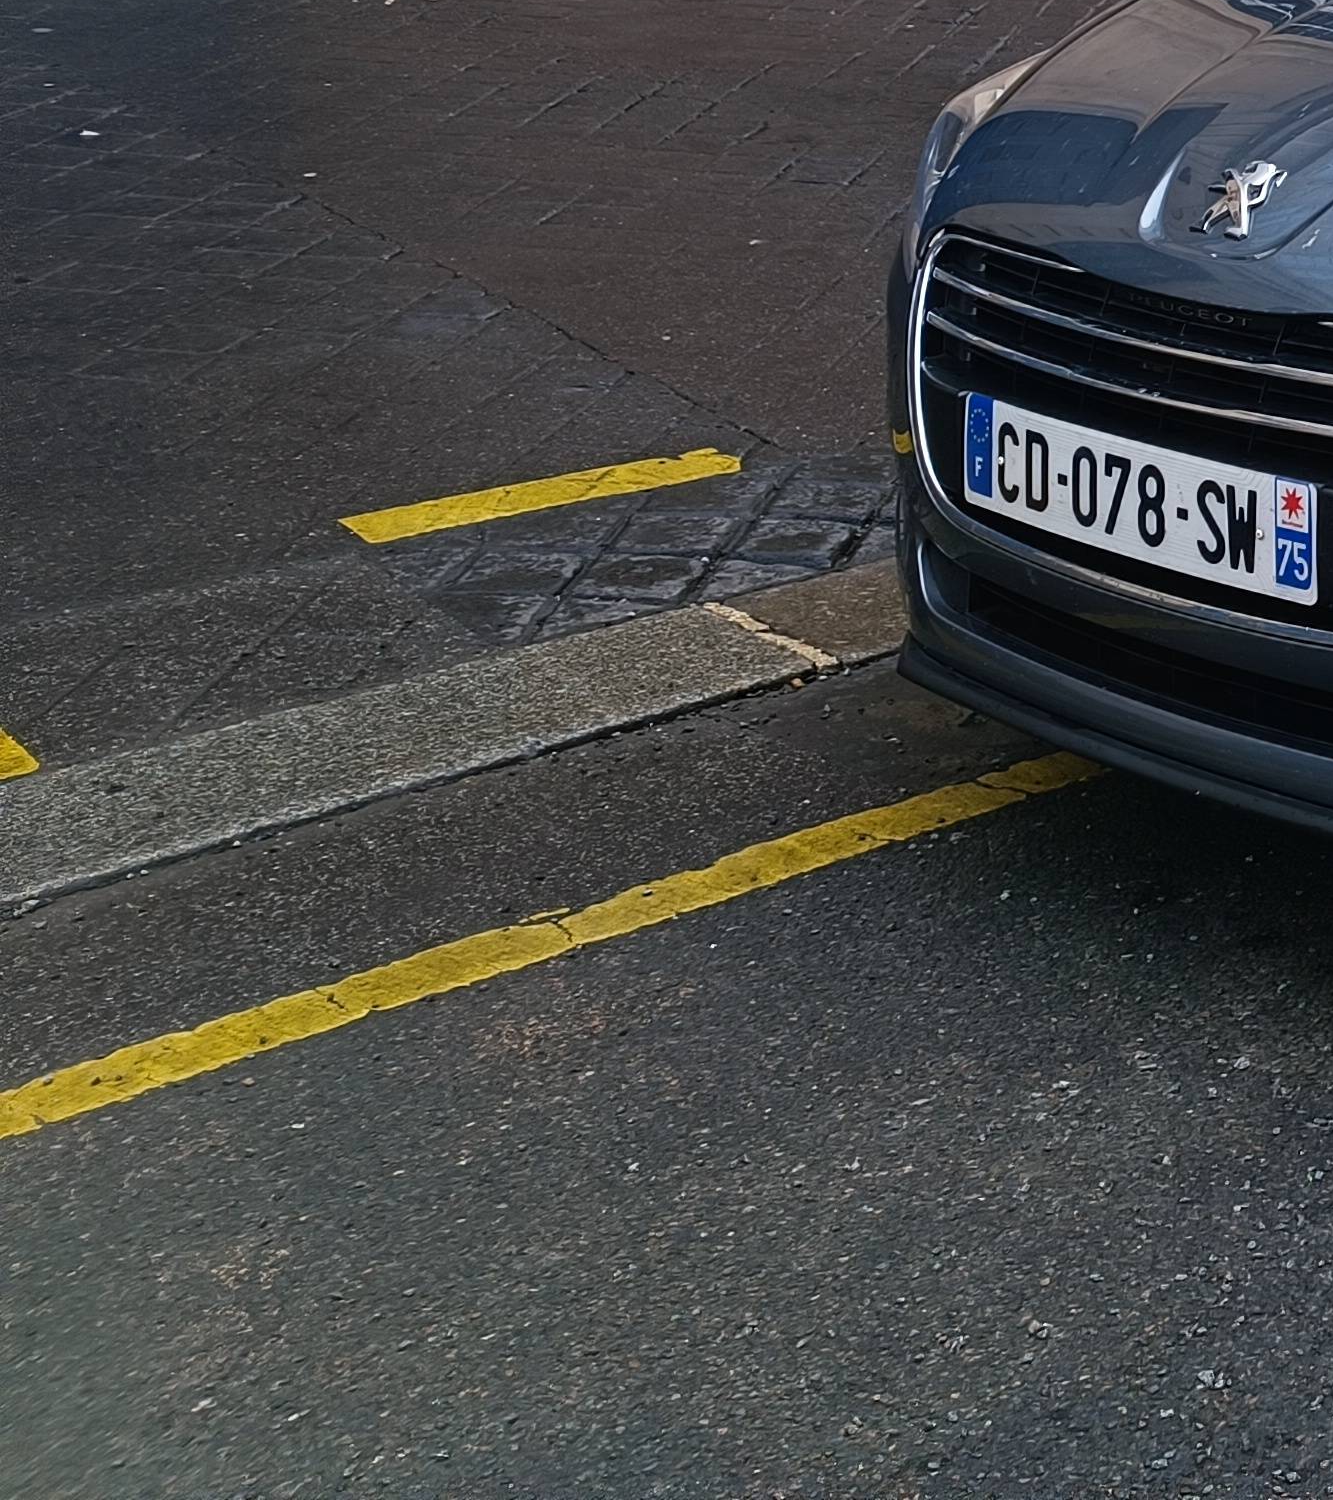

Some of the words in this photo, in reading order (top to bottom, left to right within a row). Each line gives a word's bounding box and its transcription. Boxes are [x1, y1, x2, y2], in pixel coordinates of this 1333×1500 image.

[974, 456, 984, 477] F
[997, 421, 1258, 574] CD-078-SW
[1277, 537, 1309, 581] 75
